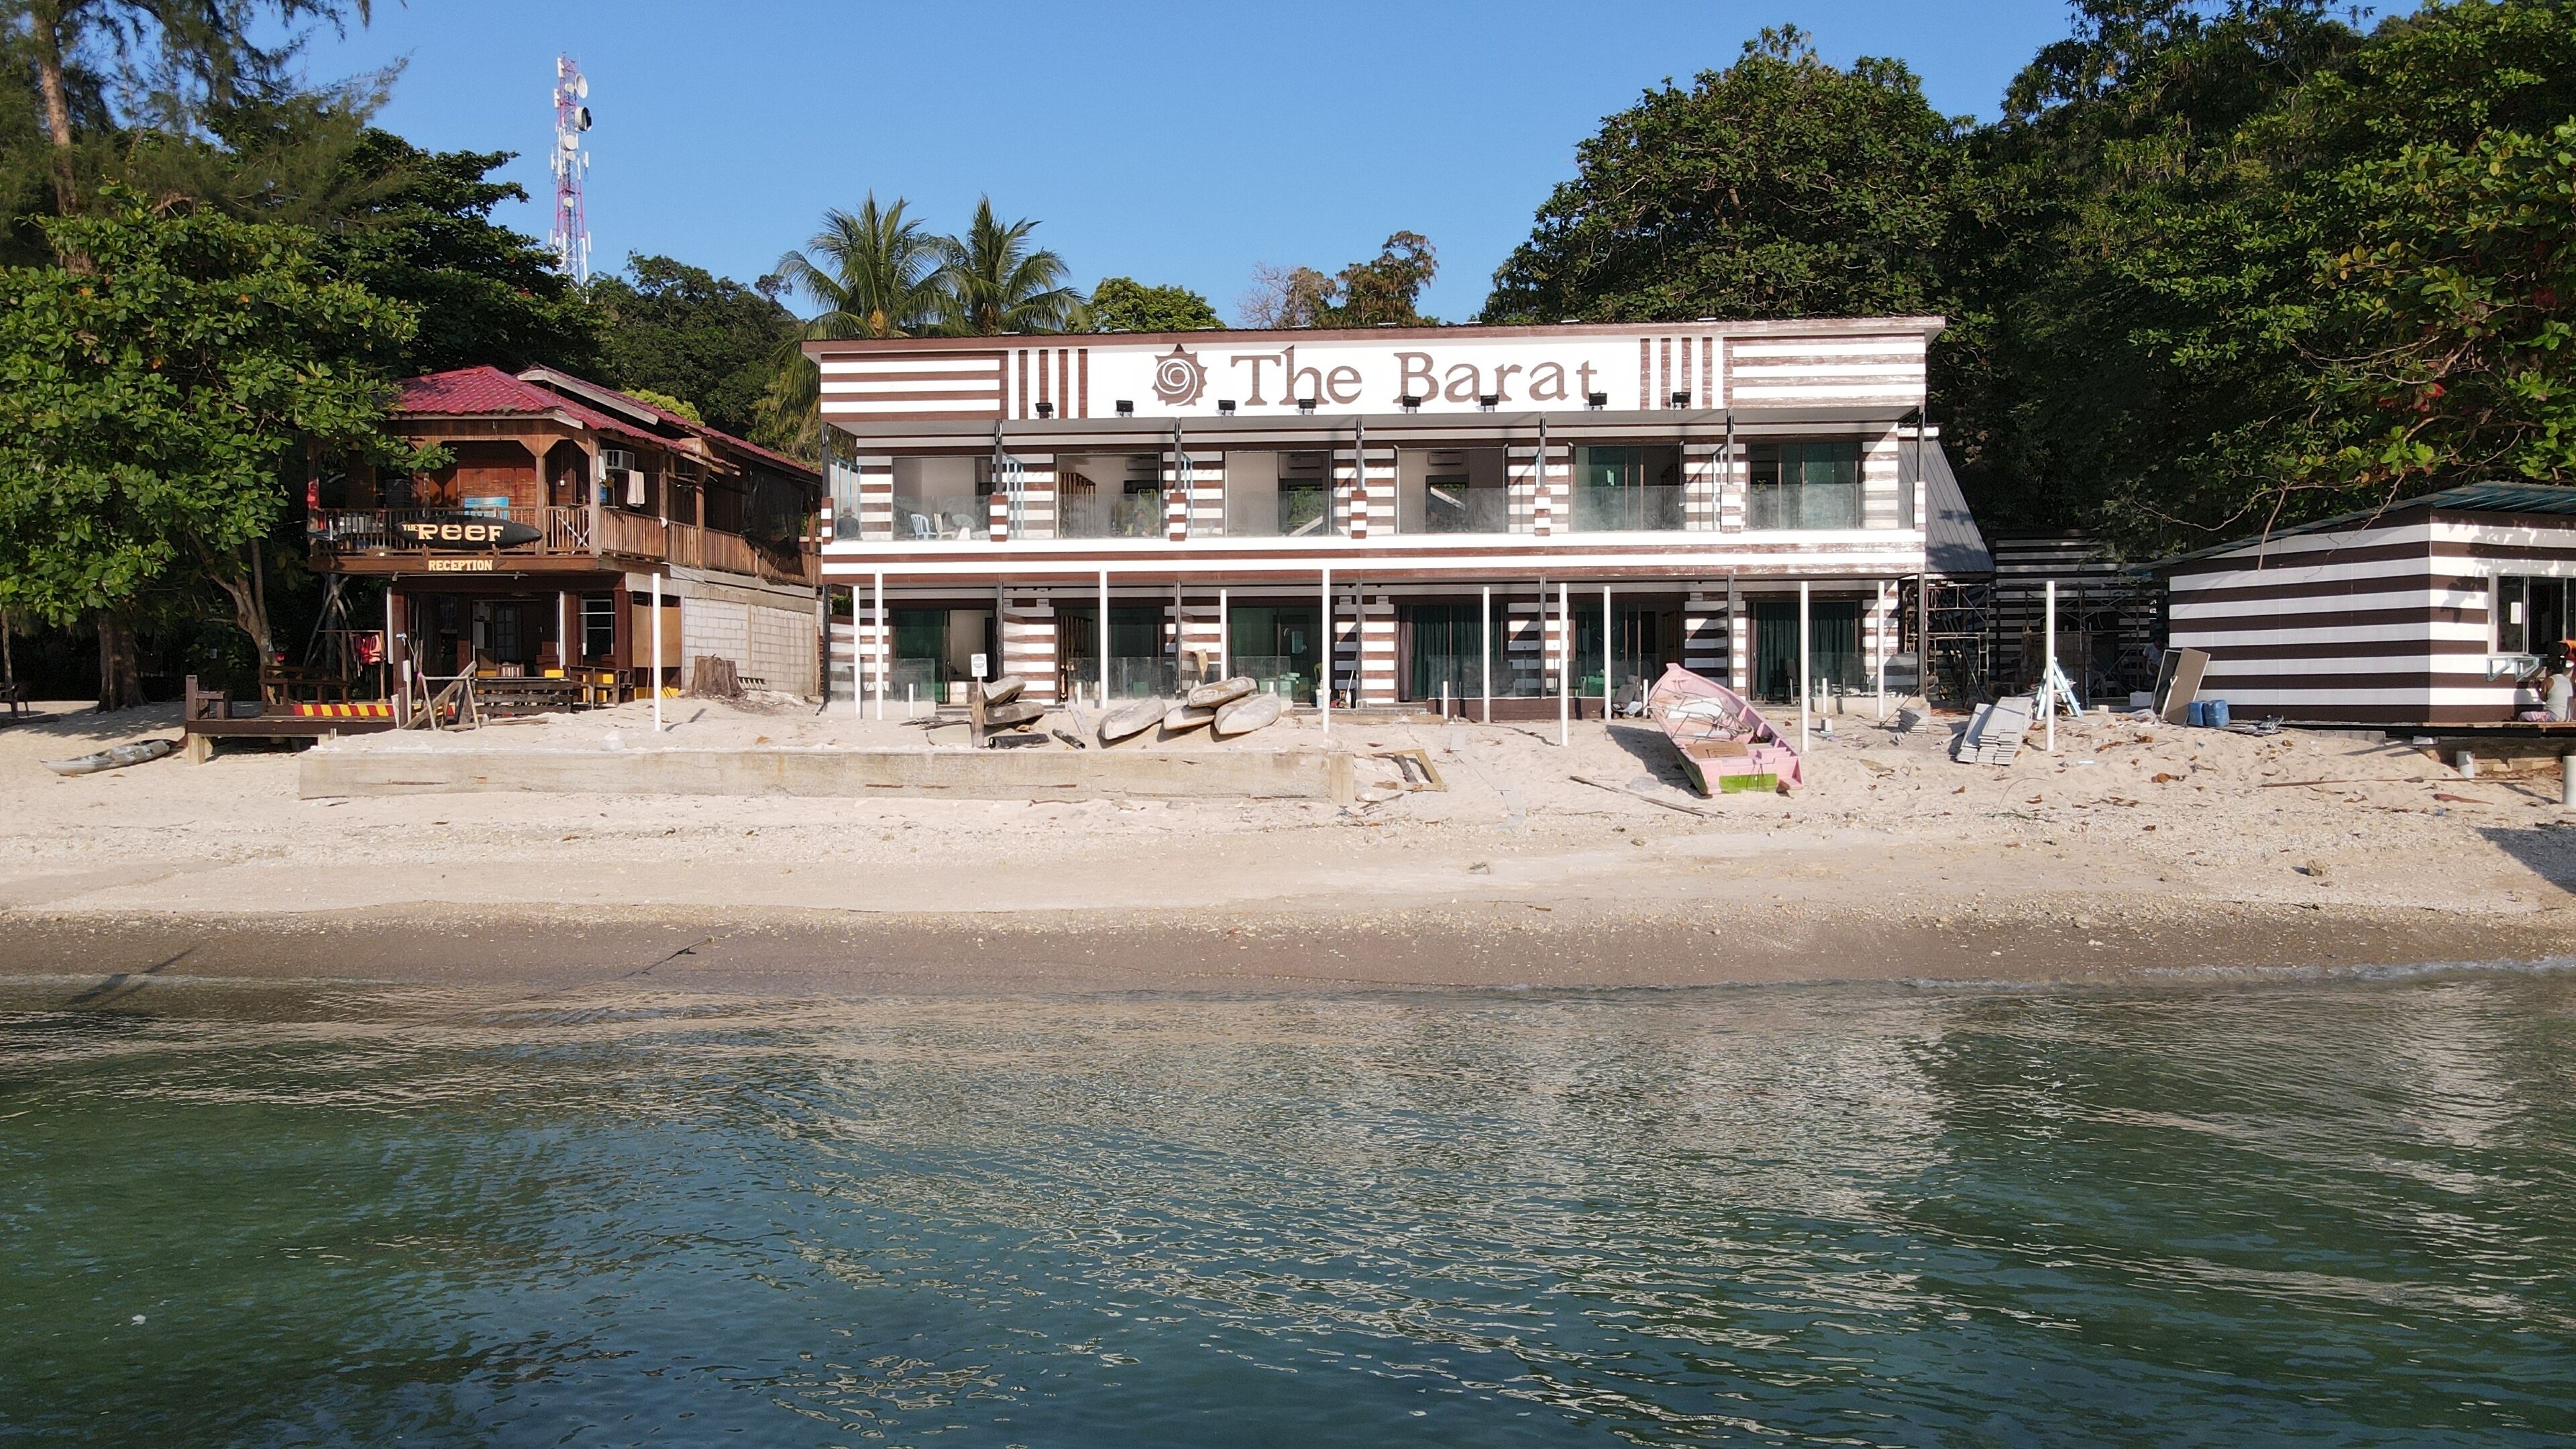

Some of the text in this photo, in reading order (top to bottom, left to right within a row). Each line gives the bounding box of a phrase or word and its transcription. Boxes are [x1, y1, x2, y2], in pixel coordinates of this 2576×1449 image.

[1230, 345, 1598, 405] The Barat
[428, 559, 493, 571] RECEPTION
